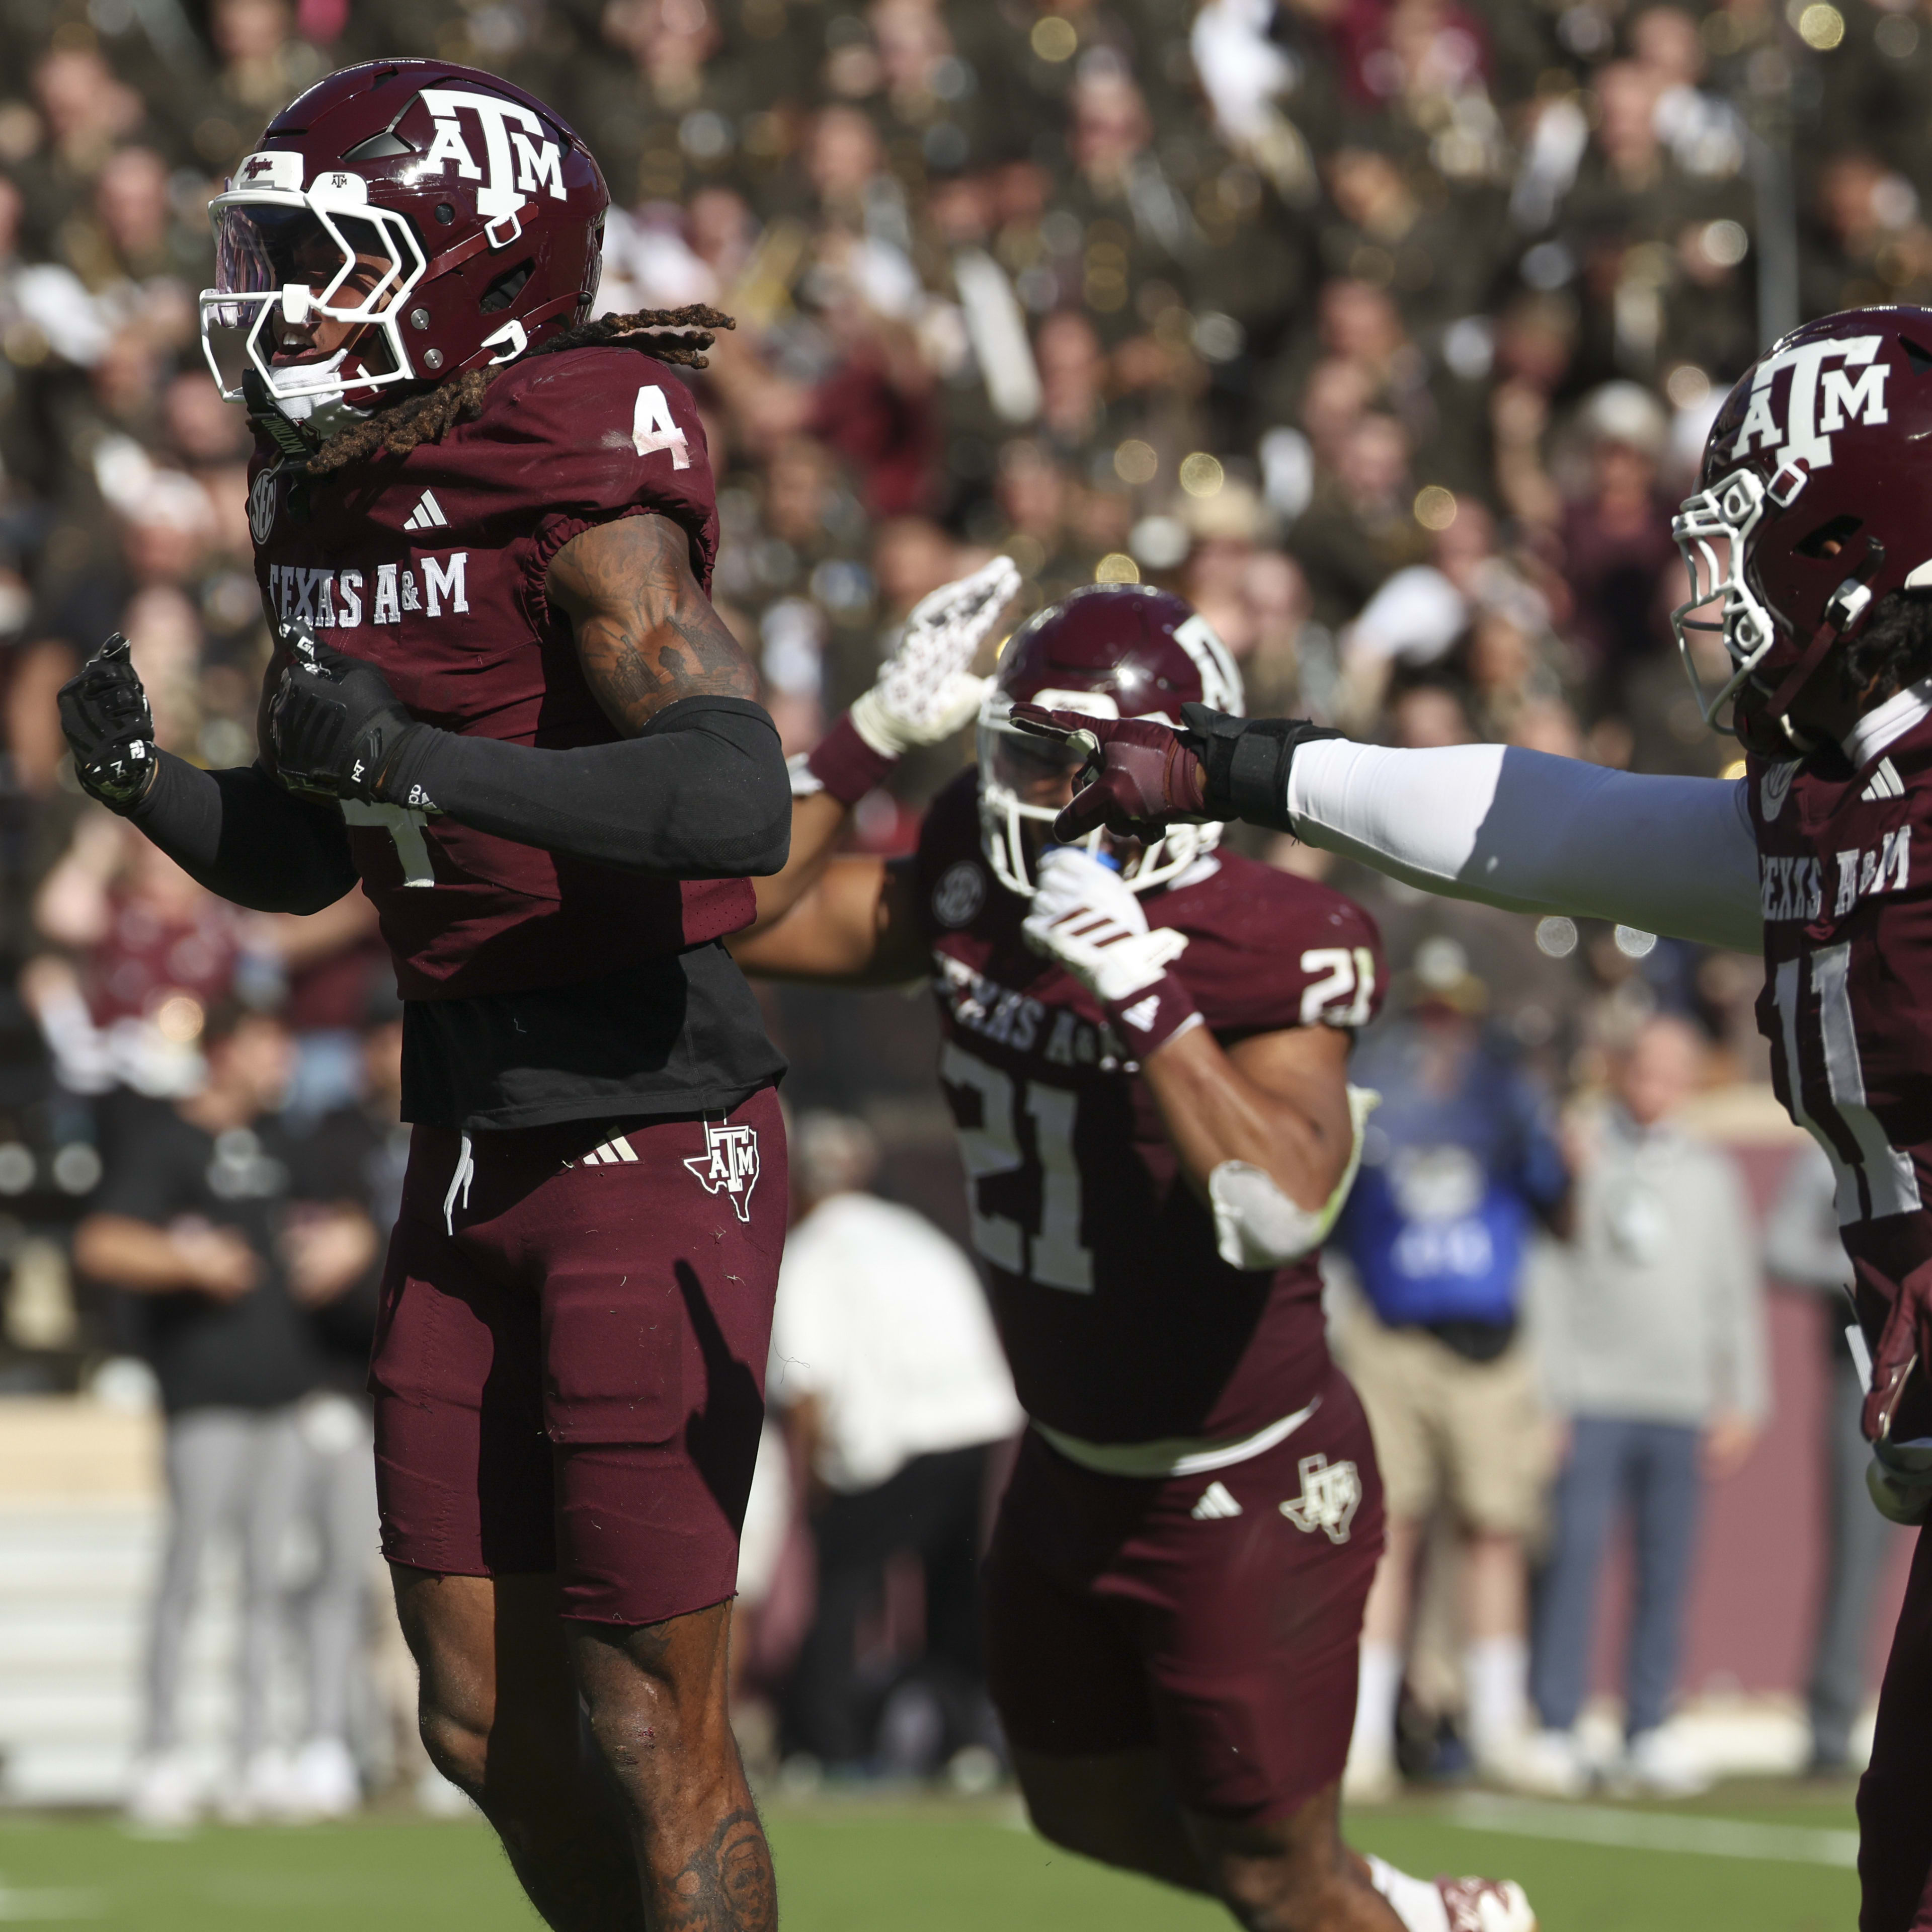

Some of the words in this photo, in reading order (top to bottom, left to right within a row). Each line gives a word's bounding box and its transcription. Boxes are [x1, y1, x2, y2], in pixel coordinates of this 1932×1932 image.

[632, 385, 691, 470] 4
[252, 474, 274, 538] SEC
[373, 552, 469, 625] A&M
[1761, 853, 1822, 921] EXAS
[1300, 945, 1375, 1027] 21
[940, 1039, 1094, 1295] 21
